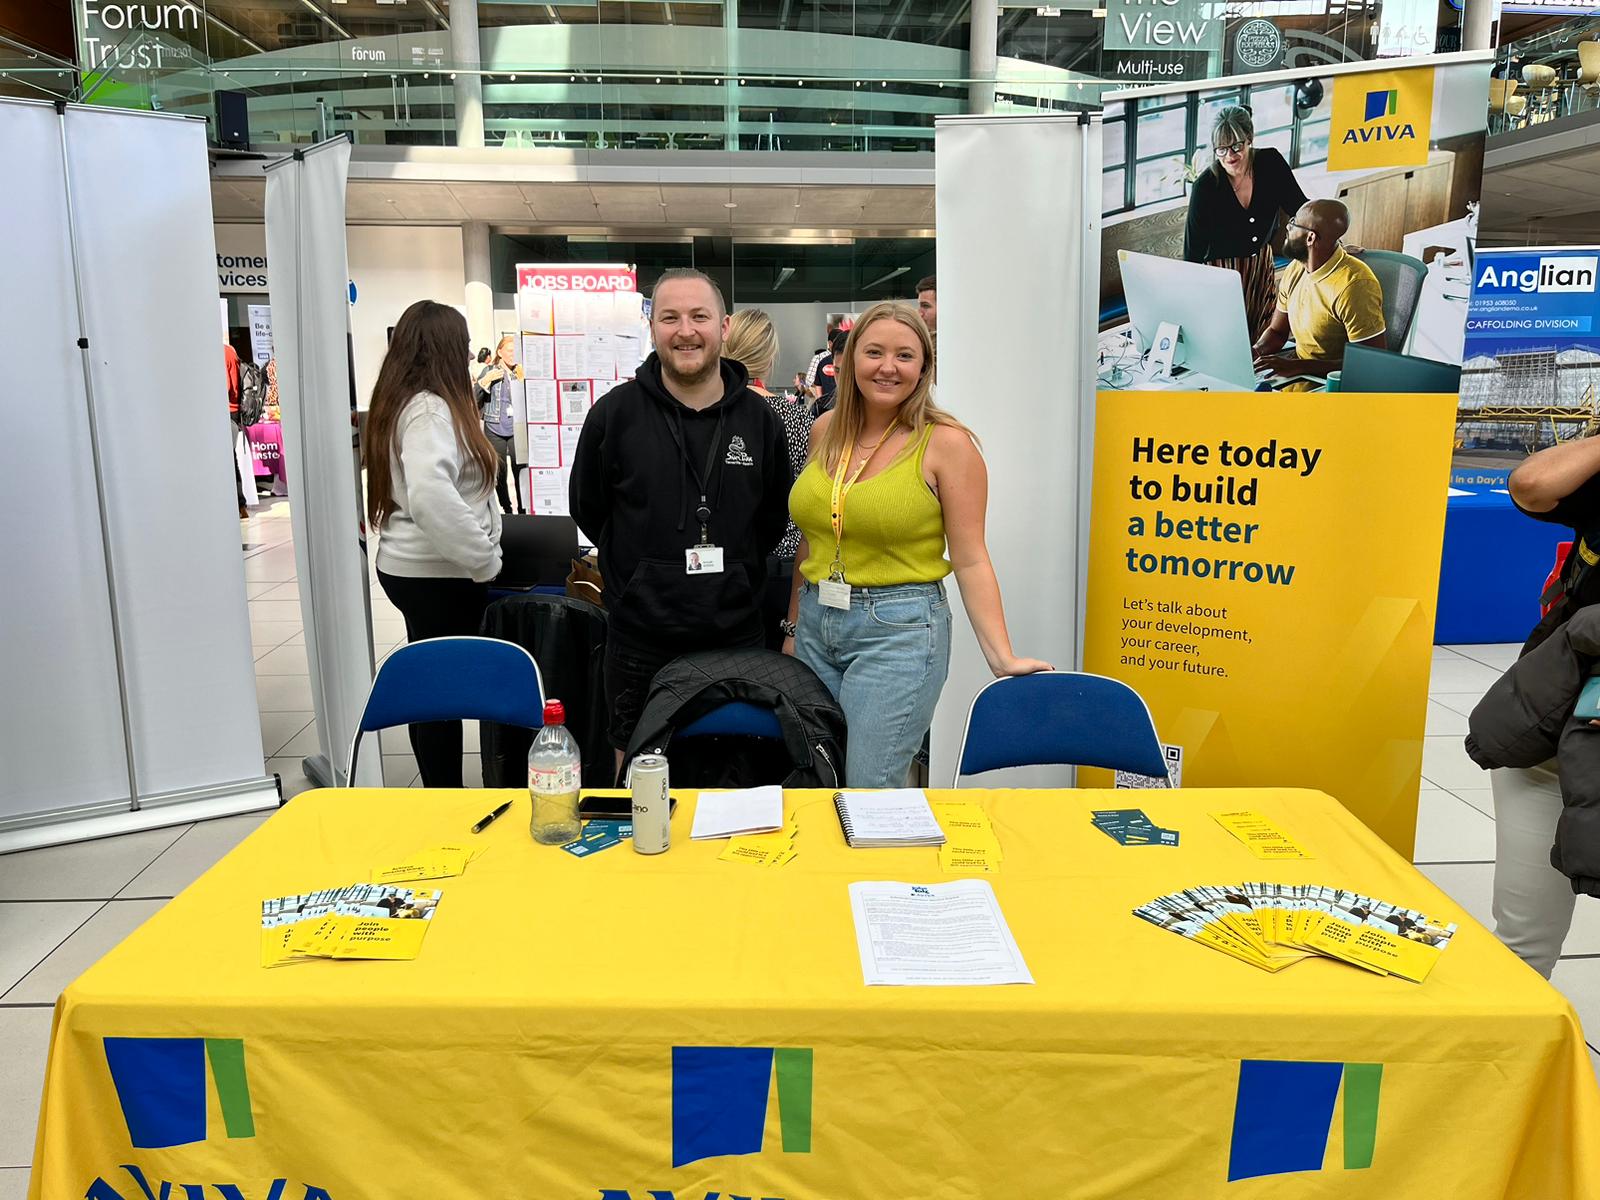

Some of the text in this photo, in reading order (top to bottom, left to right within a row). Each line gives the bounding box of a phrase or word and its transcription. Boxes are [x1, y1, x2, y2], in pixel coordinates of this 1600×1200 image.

[83, 0, 198, 30] Forum
[1120, 12, 1208, 45] View
[83, 37, 163, 69] Trust
[1117, 60, 1184, 75] Multi-use
[1342, 124, 1415, 144] AVIVA
[525, 275, 633, 290] JOBS BOARD
[1477, 265, 1592, 292] Anglian
[1535, 320, 1579, 328] DIVISION
[1132, 437, 1322, 477] Here today
[1130, 475, 1258, 505] to build
[1455, 475, 1464, 483] in
[1128, 511, 1259, 544] a better
[1126, 548, 1295, 585] tomorrow
[1157, 600, 1182, 614] talk
[1186, 604, 1228, 619] about
[1122, 618, 1252, 644] your development,
[1121, 636, 1200, 656] your career,
[1120, 654, 1228, 678] and your future.
[1361, 933, 1397, 948] people
